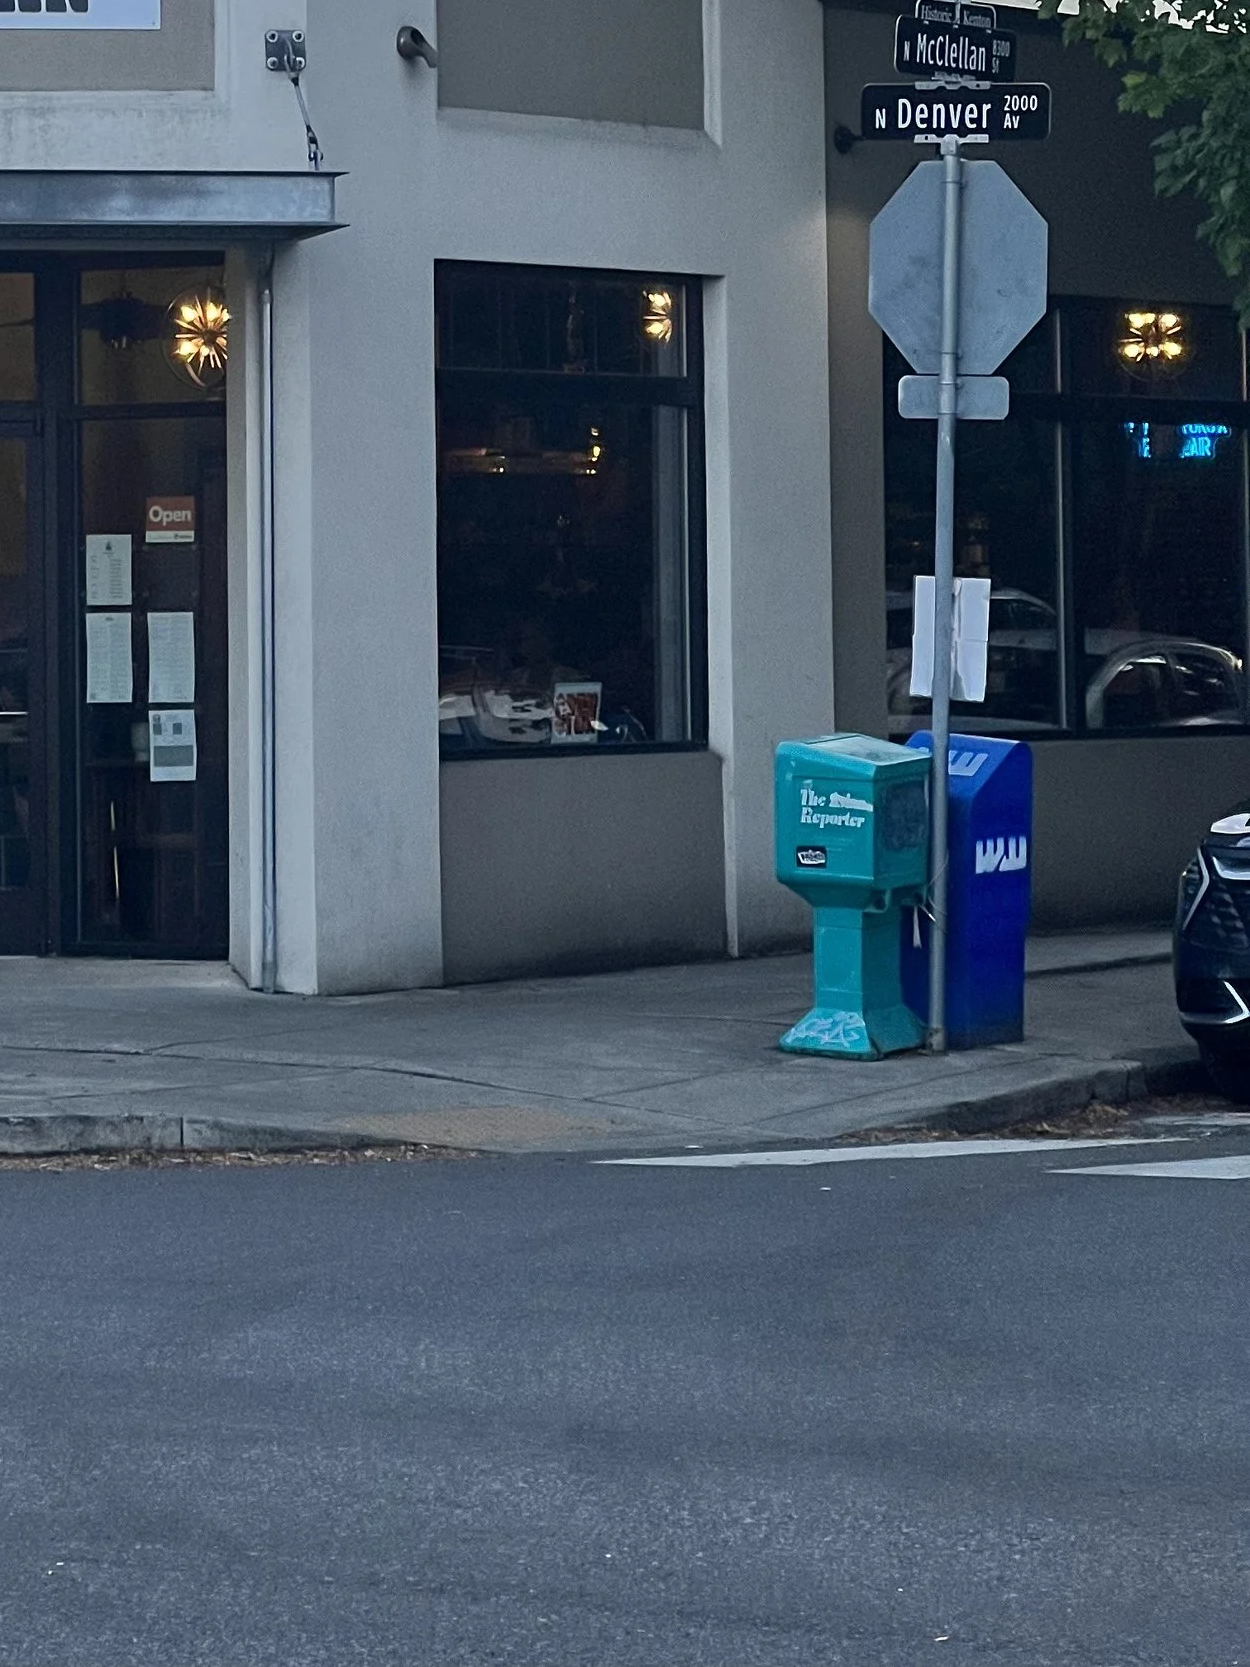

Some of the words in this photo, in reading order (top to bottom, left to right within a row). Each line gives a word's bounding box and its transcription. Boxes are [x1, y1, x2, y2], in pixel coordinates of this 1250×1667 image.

[920, 4, 952, 23] Historic
[963, 10, 991, 28] Kenton
[903, 40, 910, 62] N
[916, 32, 986, 72] McClellan
[875, 108, 886, 129] N
[897, 98, 992, 129] Denver
[1003, 95, 1038, 111] 2000
[1003, 112, 1020, 129] Av
[148, 505, 192, 526] Open
[800, 788, 826, 807] The
[800, 806, 865, 829] Reporter
